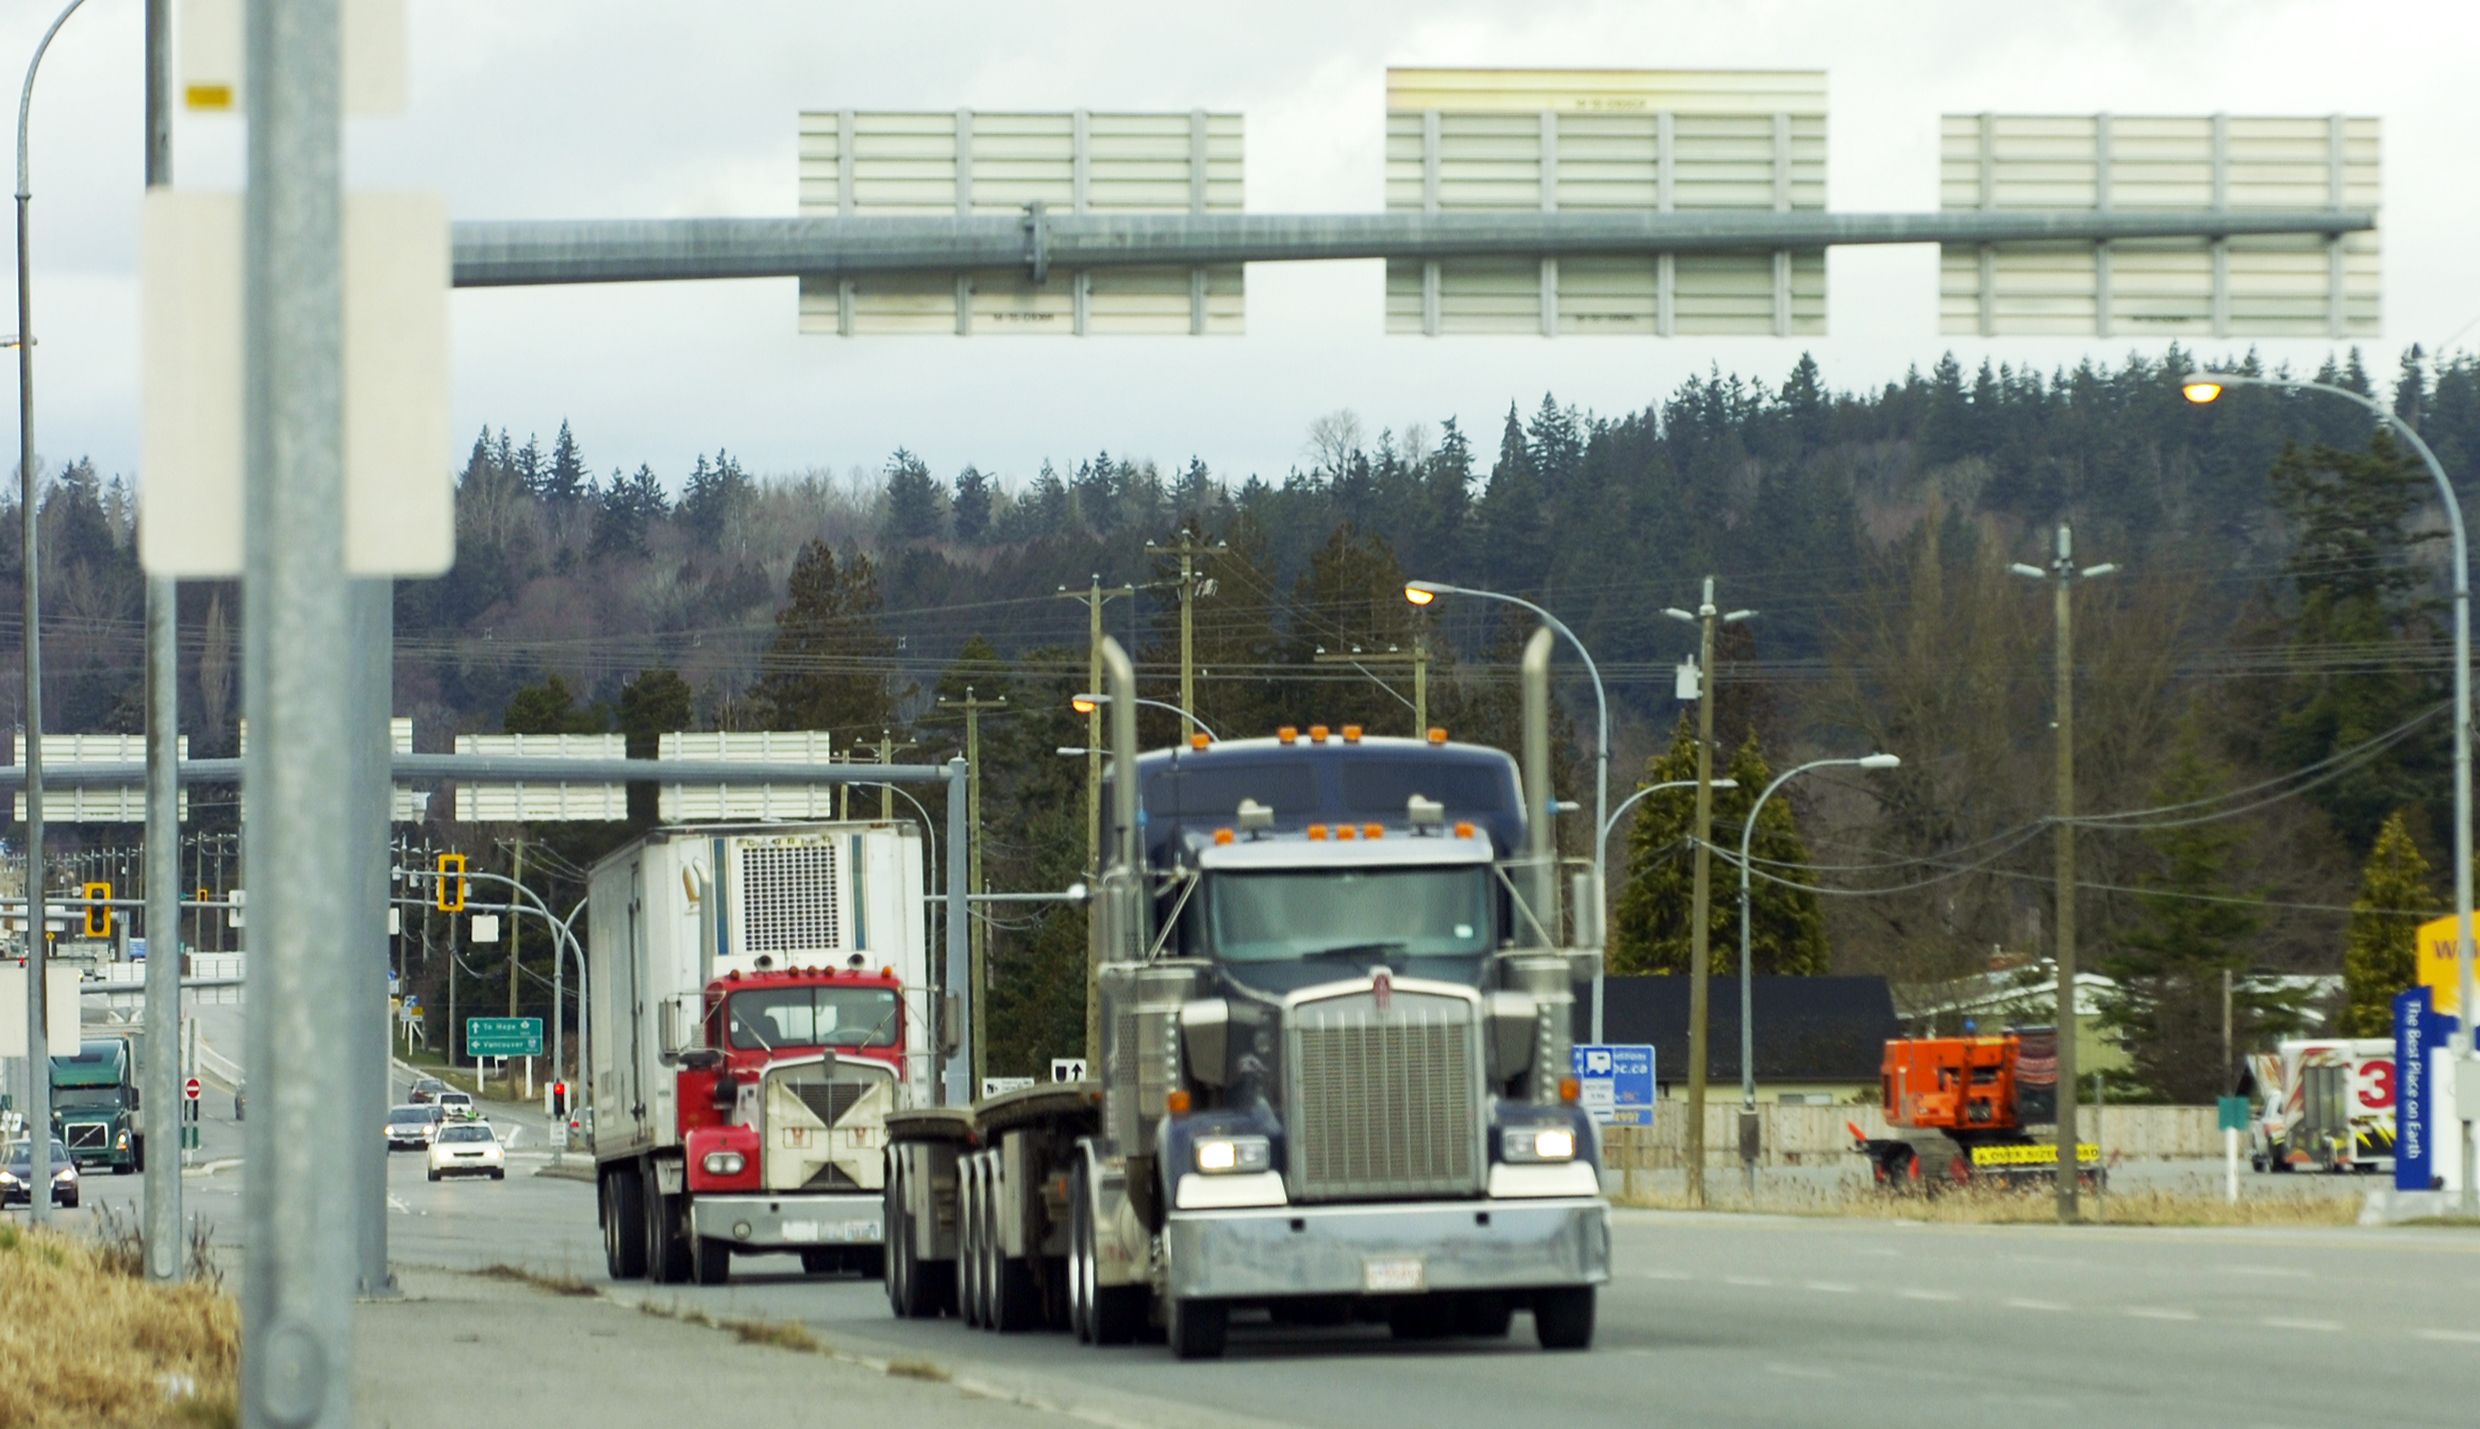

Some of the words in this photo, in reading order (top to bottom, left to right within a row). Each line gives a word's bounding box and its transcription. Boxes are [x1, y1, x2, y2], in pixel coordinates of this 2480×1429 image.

[483, 1023, 493, 1031] To
[2407, 1001, 2421, 1027] The
[2407, 1029, 2421, 1058] Best
[2407, 1060, 2421, 1098] Place
[2407, 1100, 2419, 1119] on
[2407, 1121, 2422, 1159] Earth
